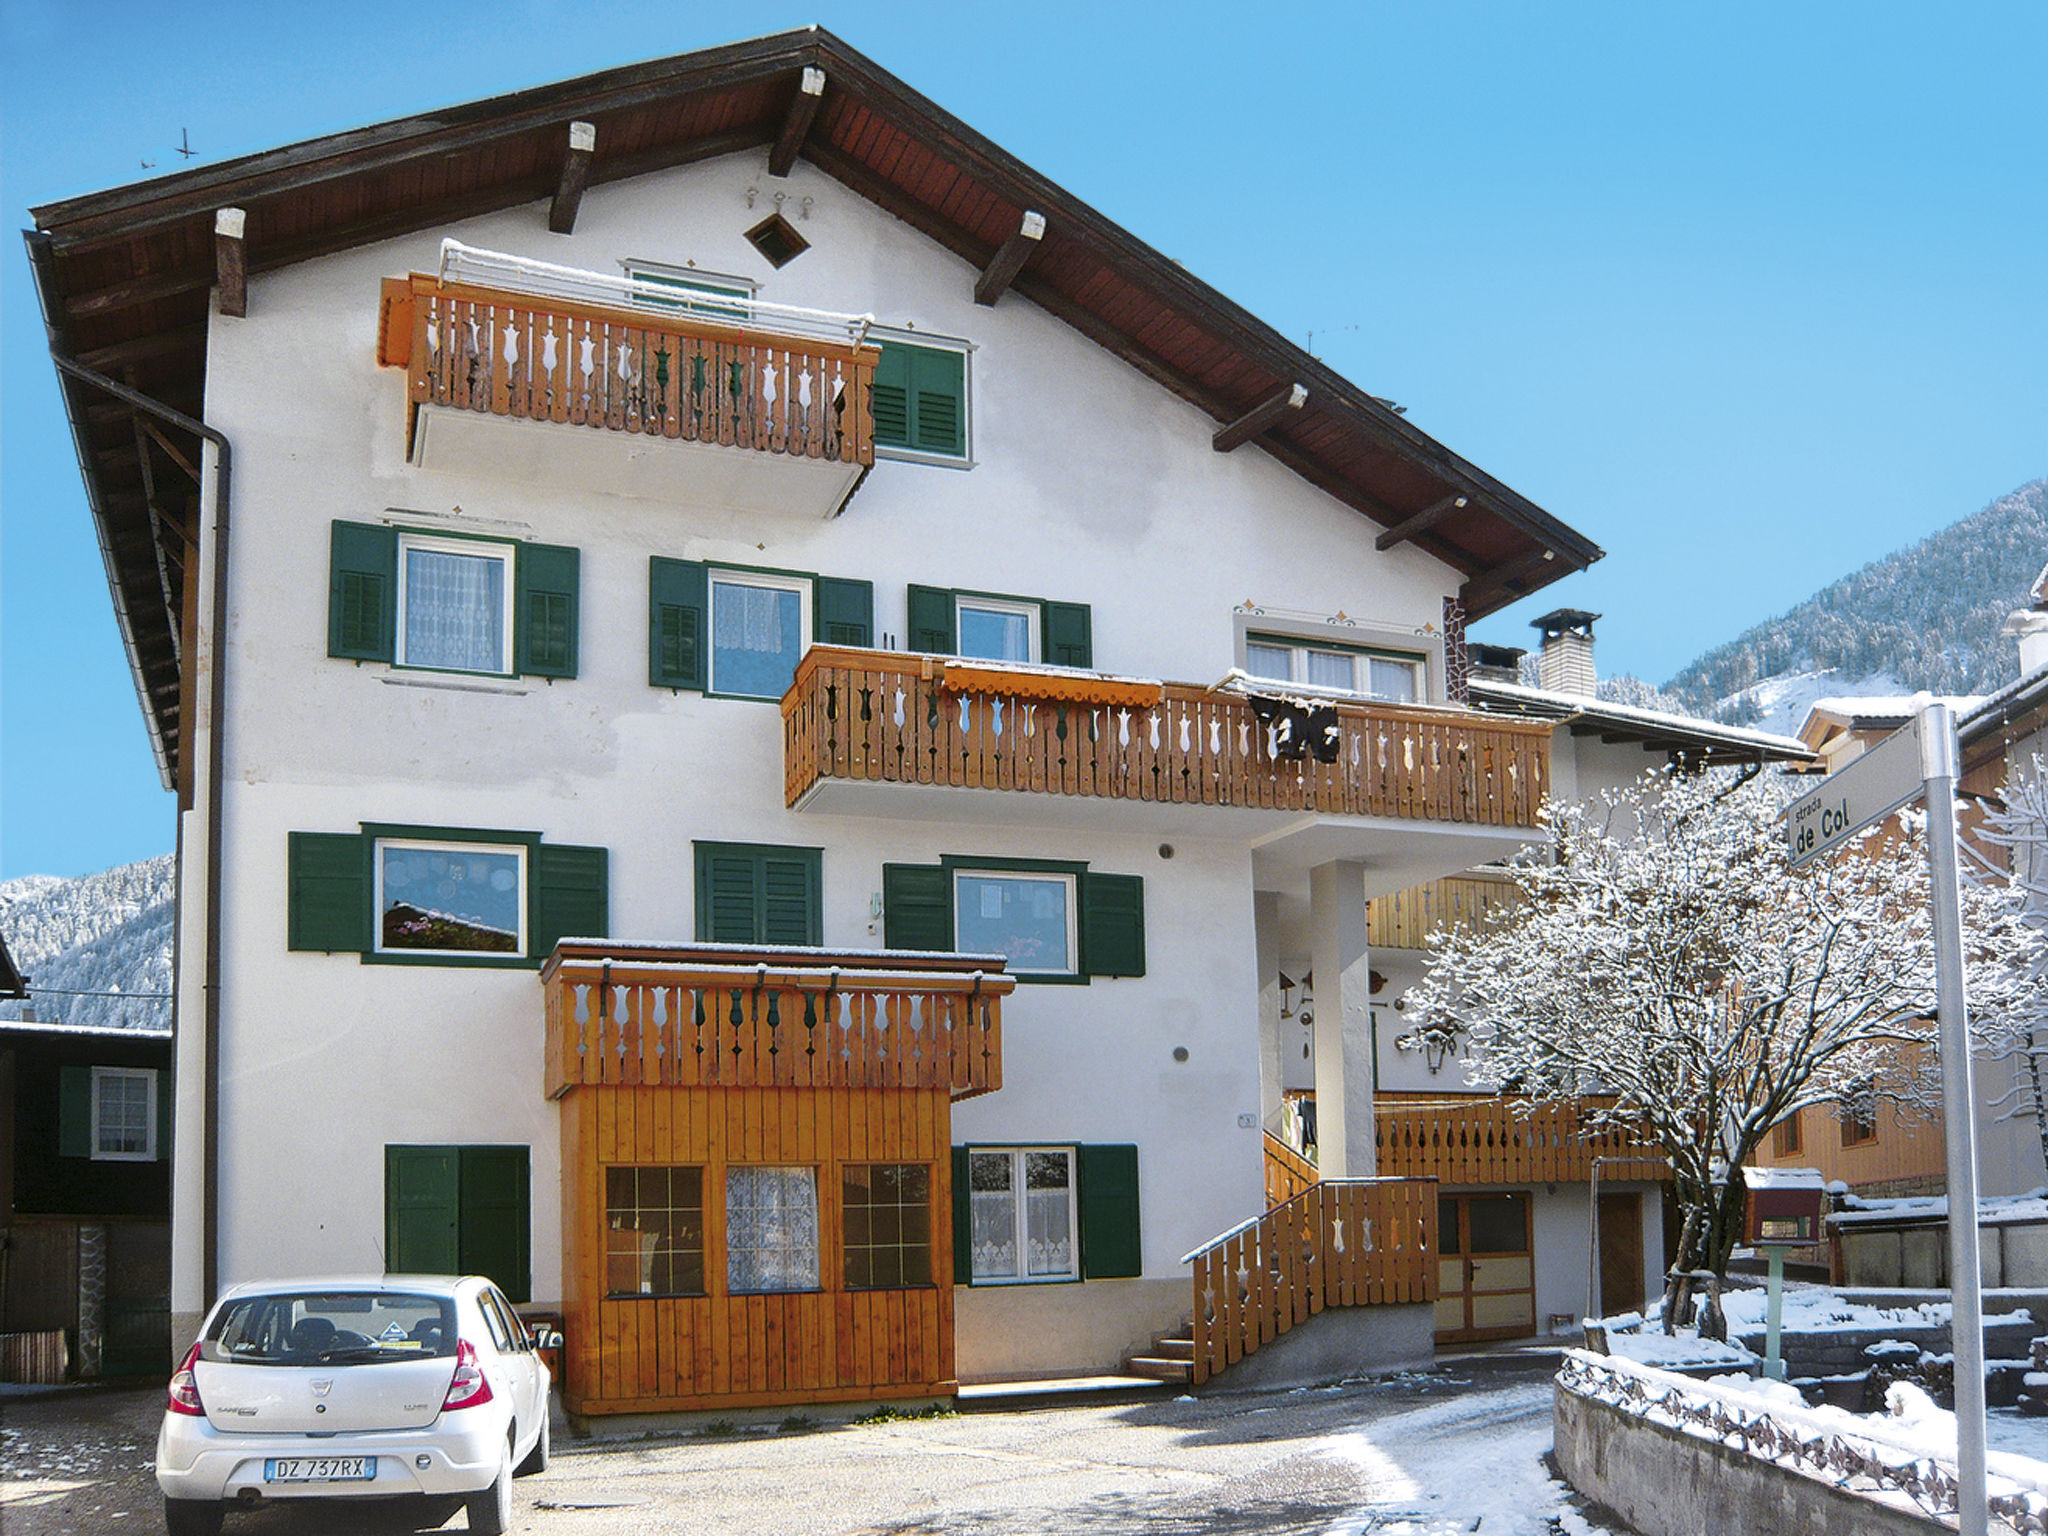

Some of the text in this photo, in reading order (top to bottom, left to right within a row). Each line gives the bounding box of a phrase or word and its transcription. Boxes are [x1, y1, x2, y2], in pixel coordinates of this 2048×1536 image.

[1795, 797, 1822, 823] strada
[1797, 798, 1849, 854] de Col
[278, 1461, 300, 1478] DZ
[307, 1459, 363, 1477] 737RX
